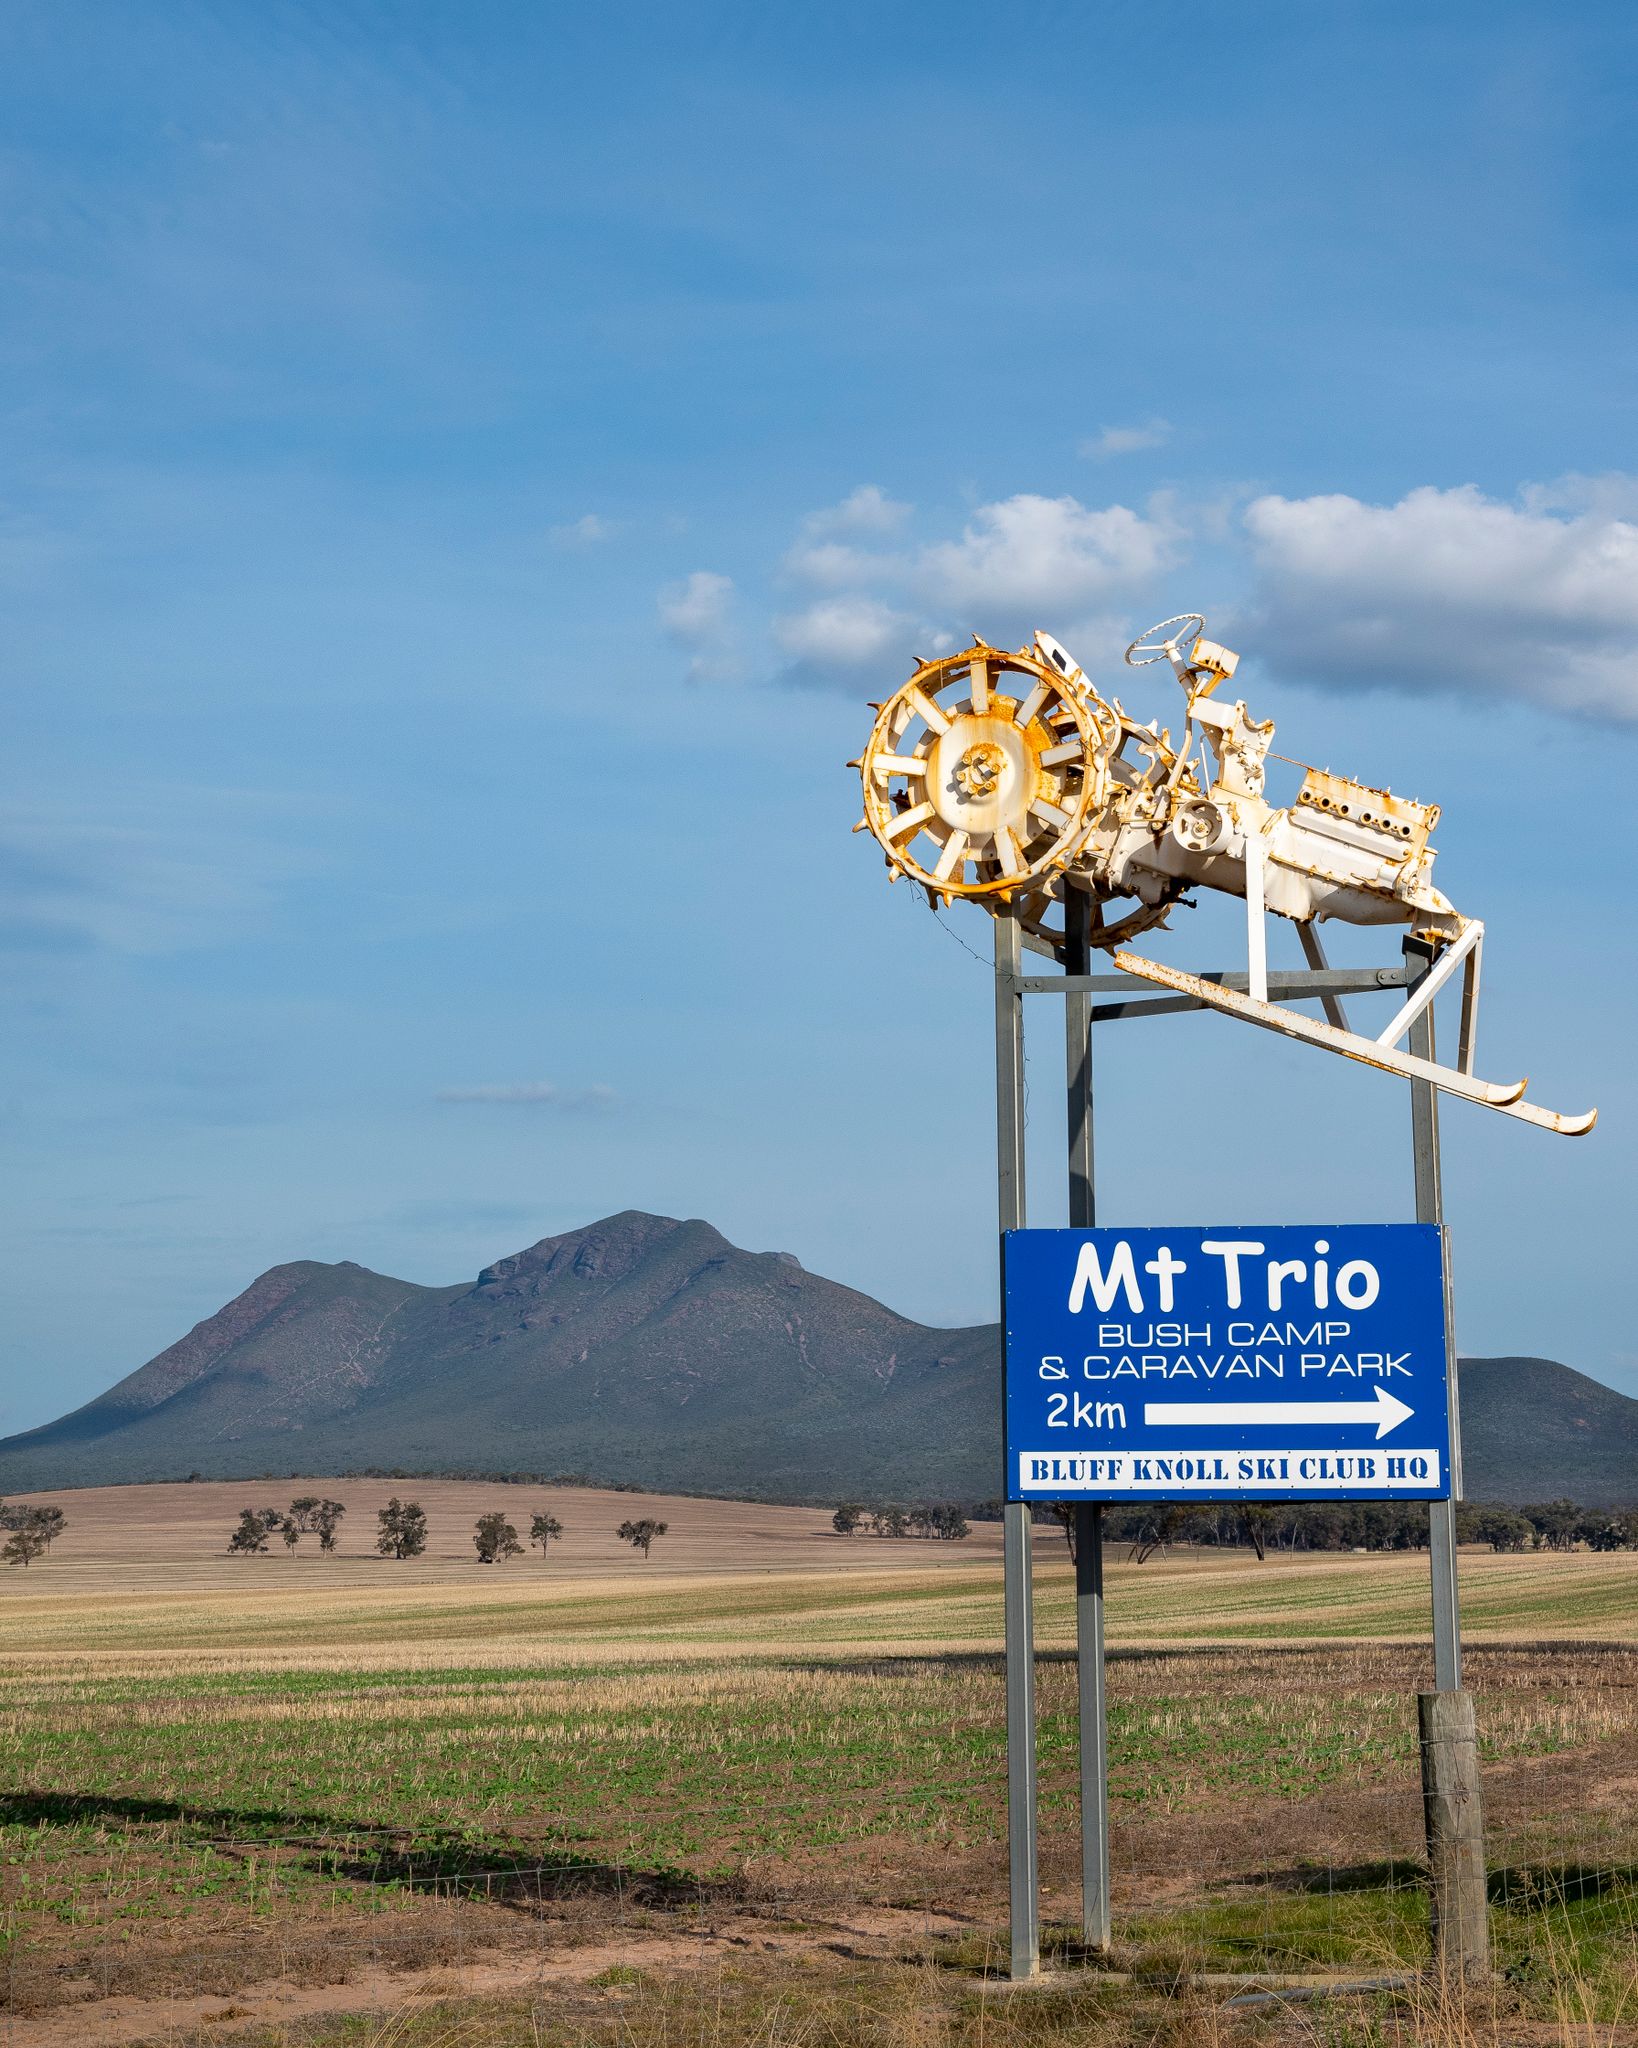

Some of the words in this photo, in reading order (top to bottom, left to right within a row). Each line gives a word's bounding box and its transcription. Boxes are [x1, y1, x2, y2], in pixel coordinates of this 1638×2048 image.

[1069, 1241, 1186, 1313] Mt
[1201, 1240, 1379, 1311] Trio
[1099, 1324, 1210, 1347] BUSH
[1228, 1322, 1350, 1346] CAMP
[1039, 1356, 1069, 1379] &
[1084, 1355, 1283, 1379] CARAVAN
[1301, 1353, 1413, 1377] PARK
[1048, 1392, 1126, 1429] 2km
[1032, 1460, 1122, 1480] BLUFF
[1133, 1459, 1228, 1480] KNOLL
[1239, 1459, 1288, 1479] SKI
[1300, 1458, 1375, 1479] CLUB
[1387, 1457, 1427, 1479] HQ
